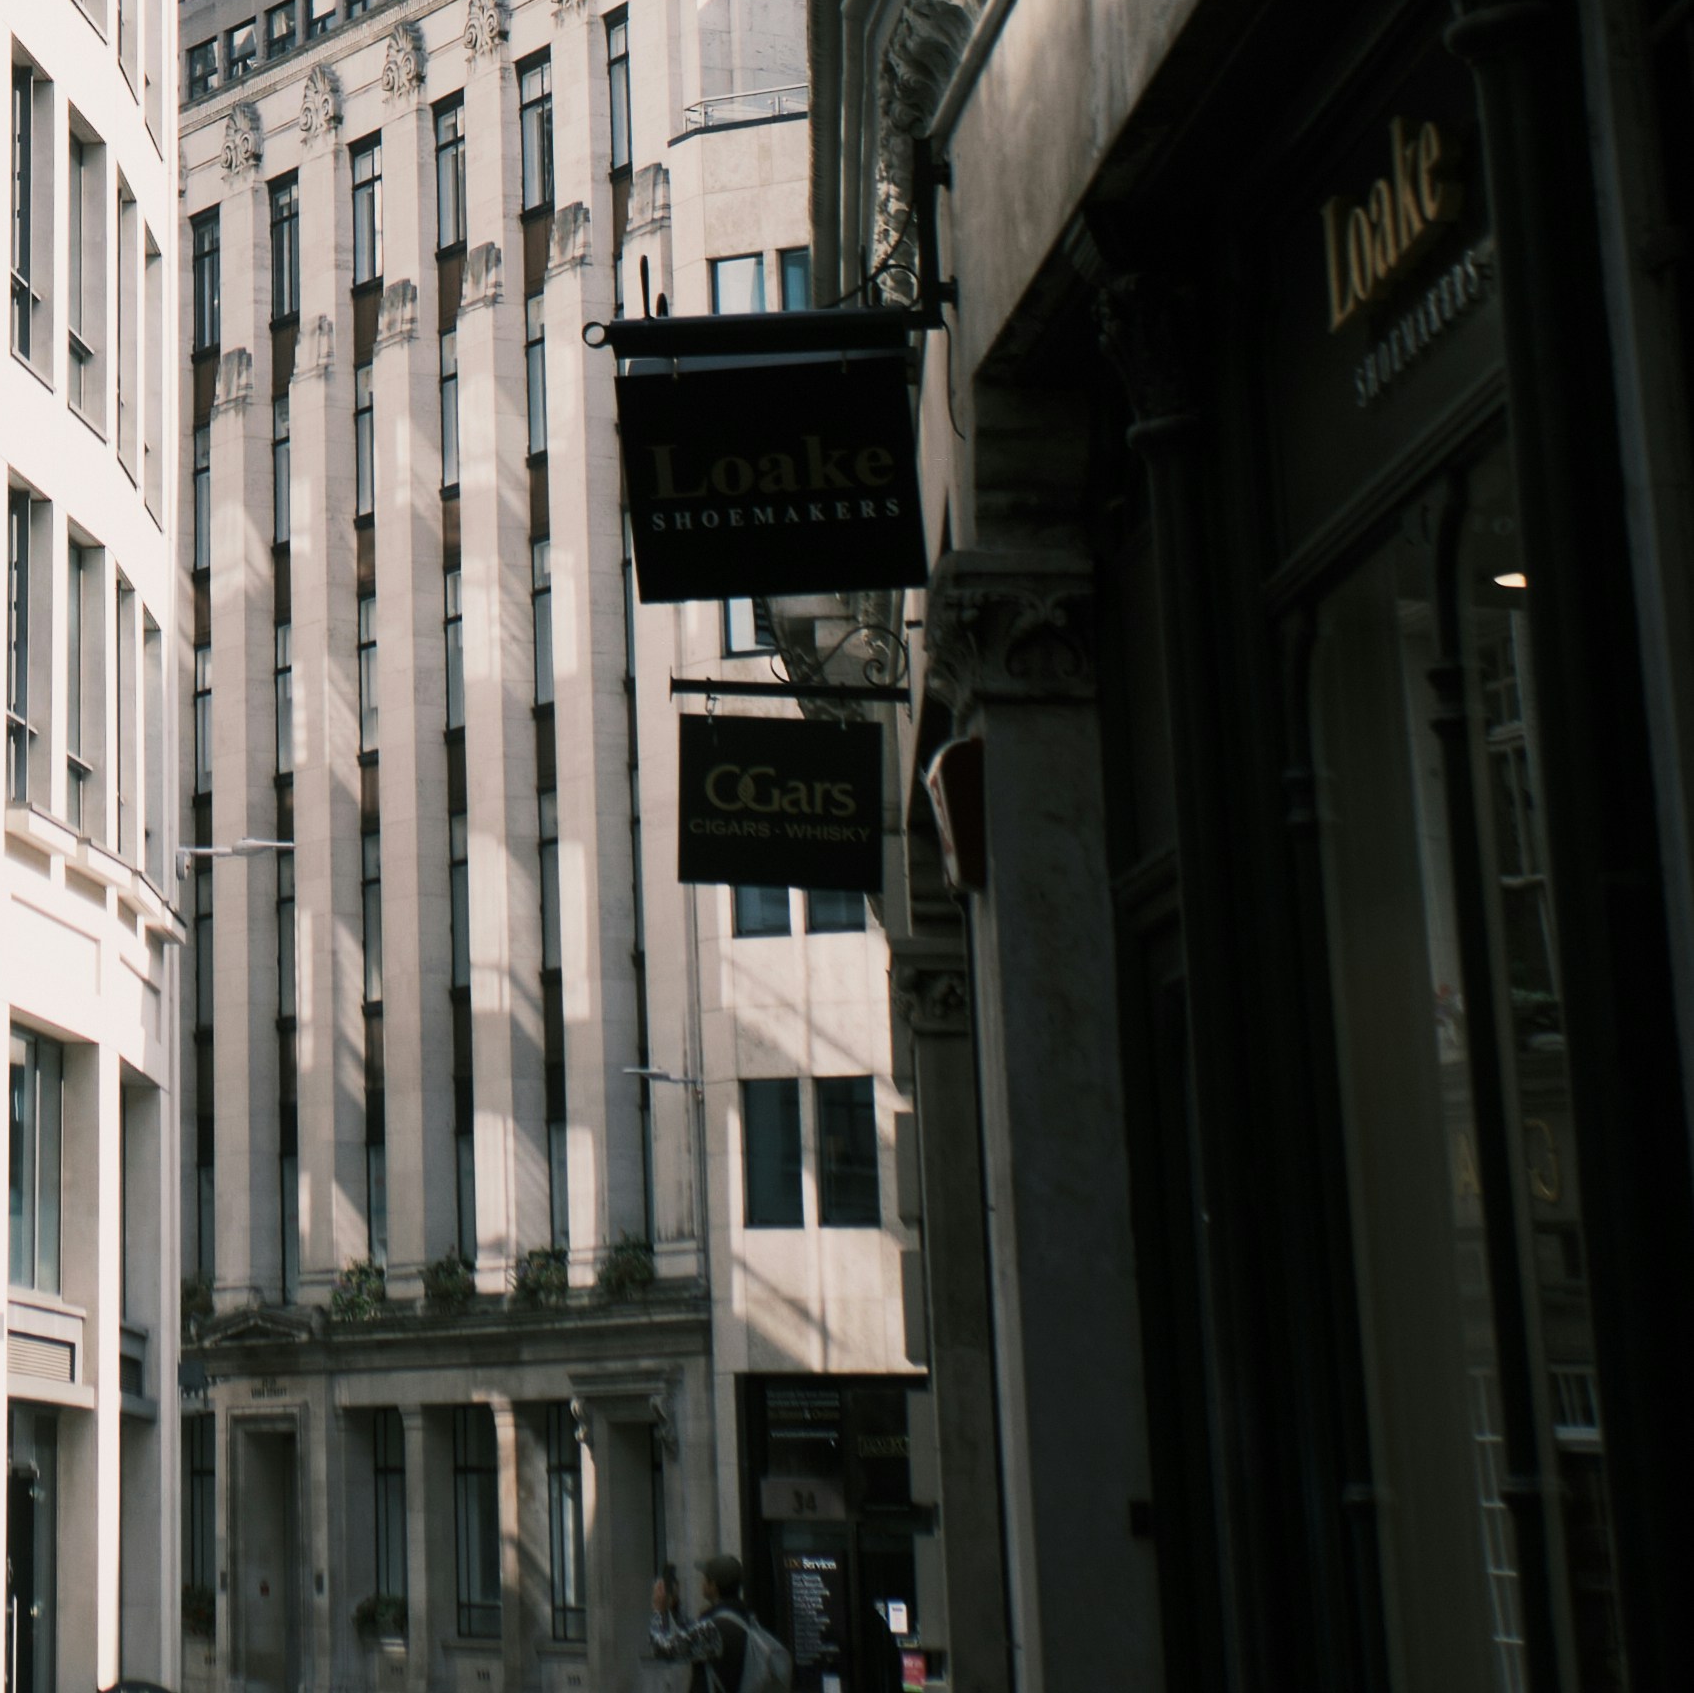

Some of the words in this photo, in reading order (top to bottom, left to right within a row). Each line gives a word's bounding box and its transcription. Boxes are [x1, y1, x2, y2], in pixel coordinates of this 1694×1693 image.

[1319, 114, 1443, 335] Loake
[643, 434, 897, 501] Loake
[650, 496, 901, 532] SHOEMAKERS
[688, 817, 772, 839] CIGARS
[783, 821, 872, 843] WHISKY
